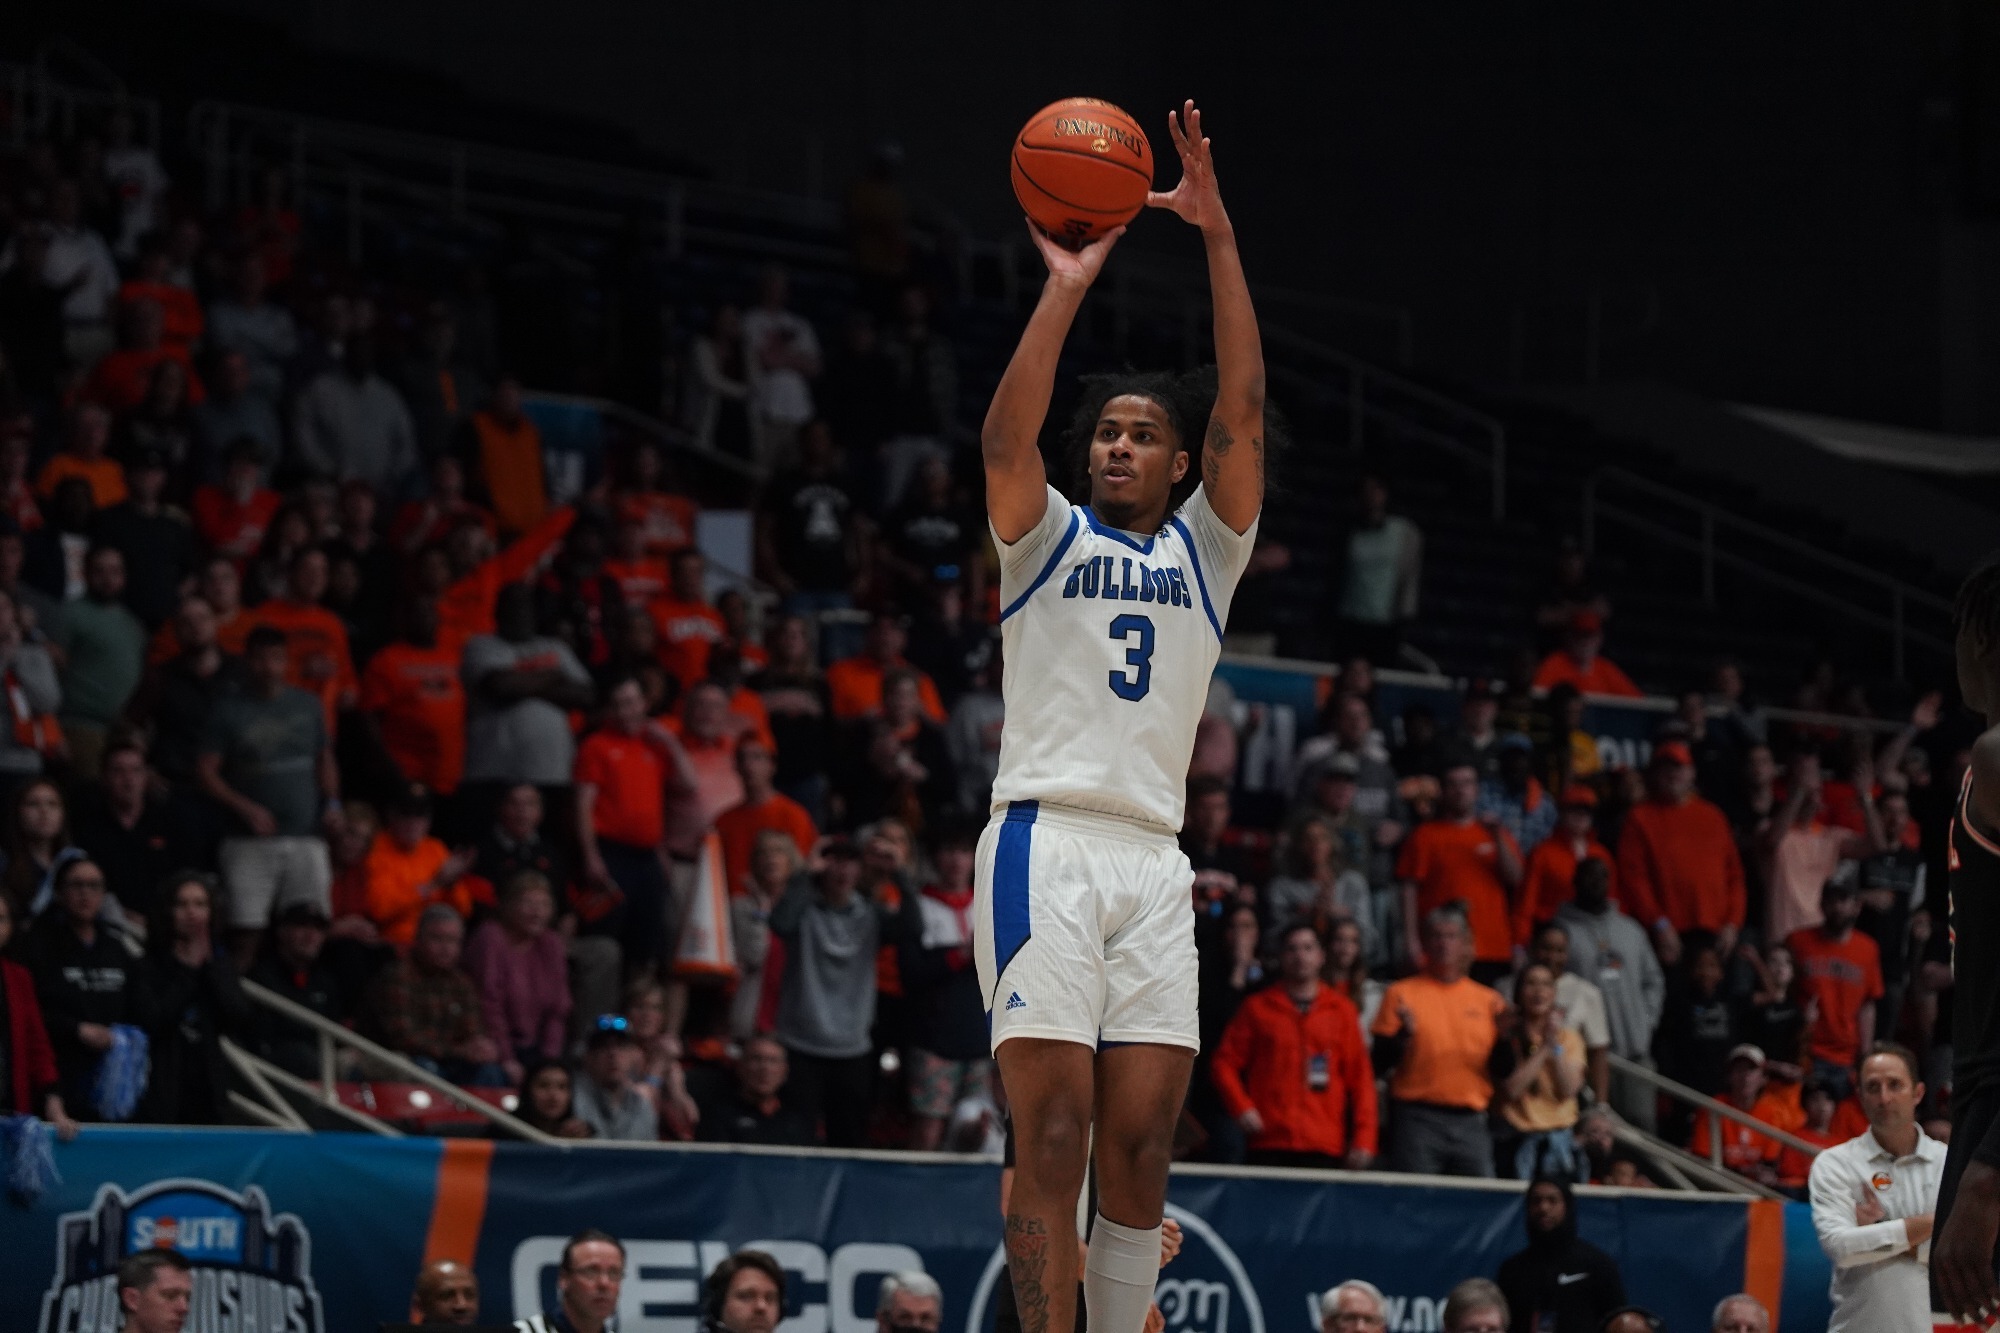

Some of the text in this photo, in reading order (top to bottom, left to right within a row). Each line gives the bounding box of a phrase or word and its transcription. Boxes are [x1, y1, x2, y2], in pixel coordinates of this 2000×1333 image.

[1054, 117, 1144, 158] SPALDING
[1063, 556, 1192, 609] BULLDOGS
[1109, 613, 1155, 702] 3
[1005, 1001, 1027, 1011] adidas
